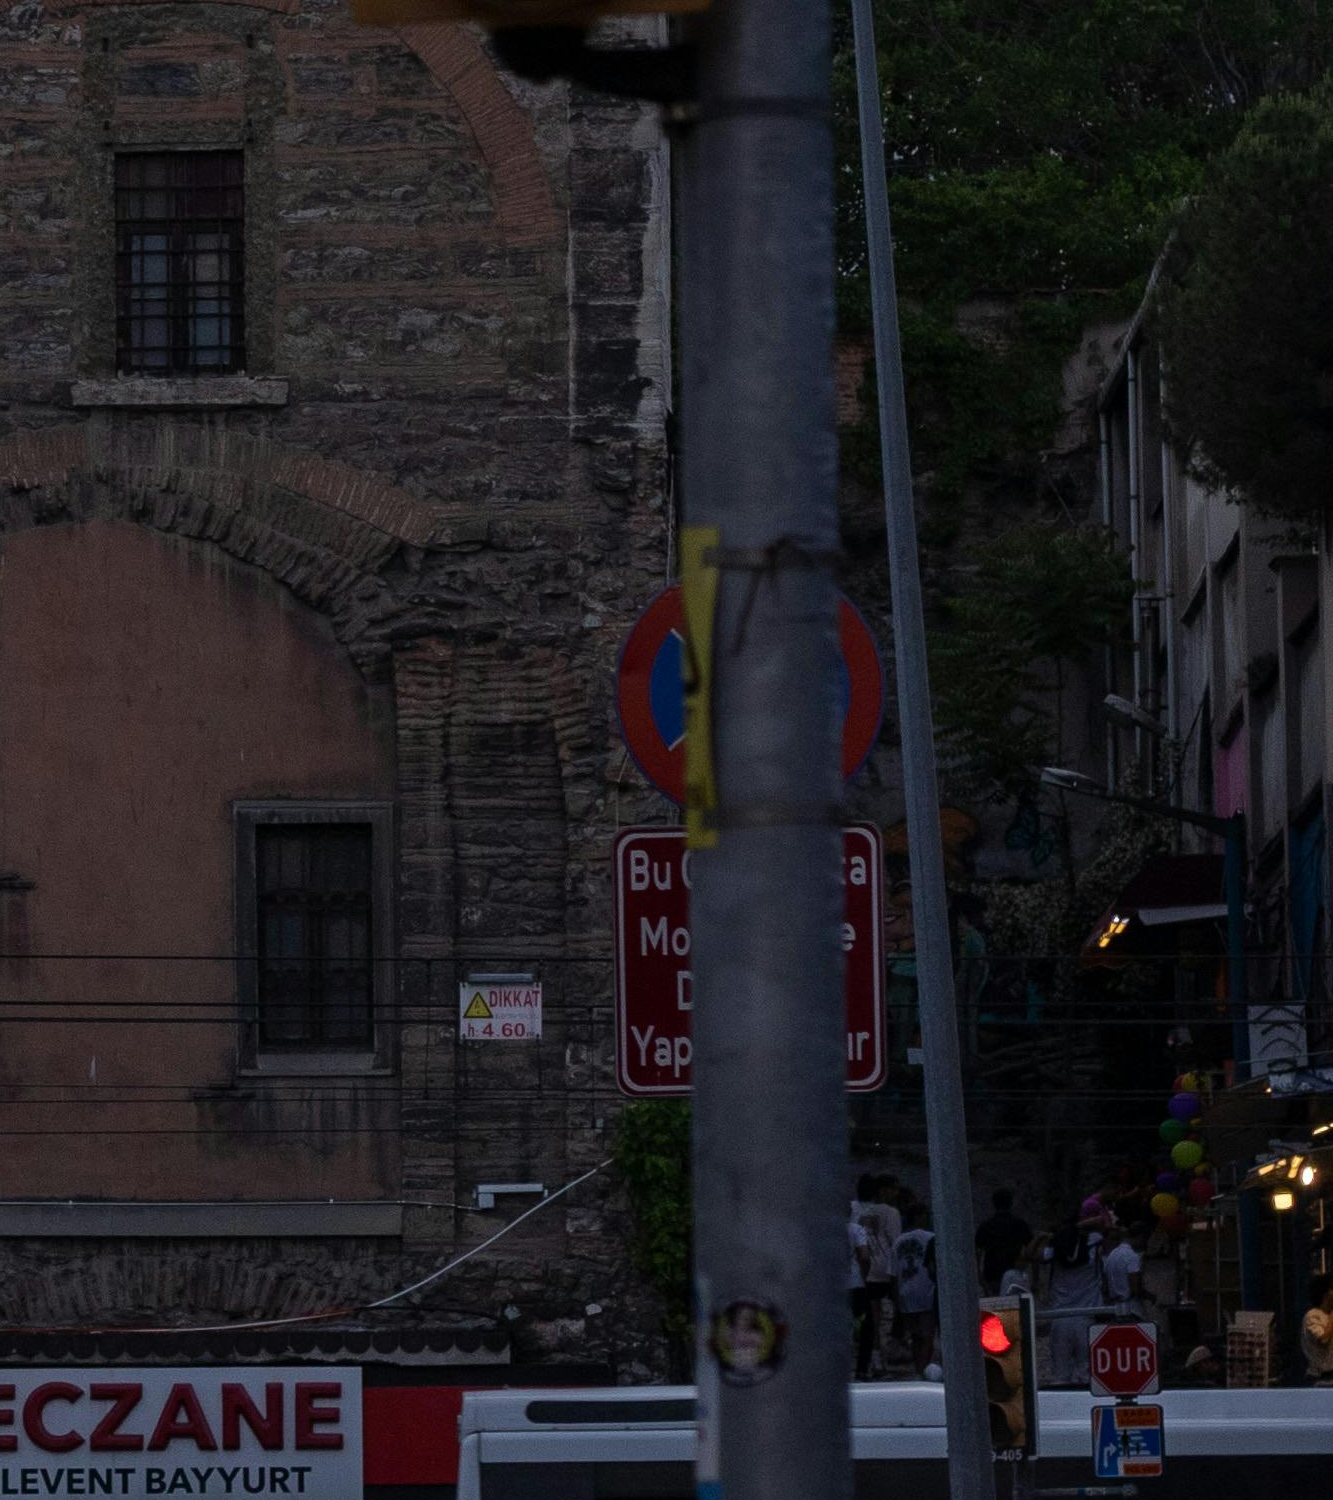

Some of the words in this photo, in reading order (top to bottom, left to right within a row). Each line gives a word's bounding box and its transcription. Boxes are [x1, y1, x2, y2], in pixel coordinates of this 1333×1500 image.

[629, 849, 672, 891] Bu
[1097, 1347, 1151, 1373] DUR
[1, 1468, 136, 1494] LEVENT
[145, 1466, 312, 1494] BAYYURT
